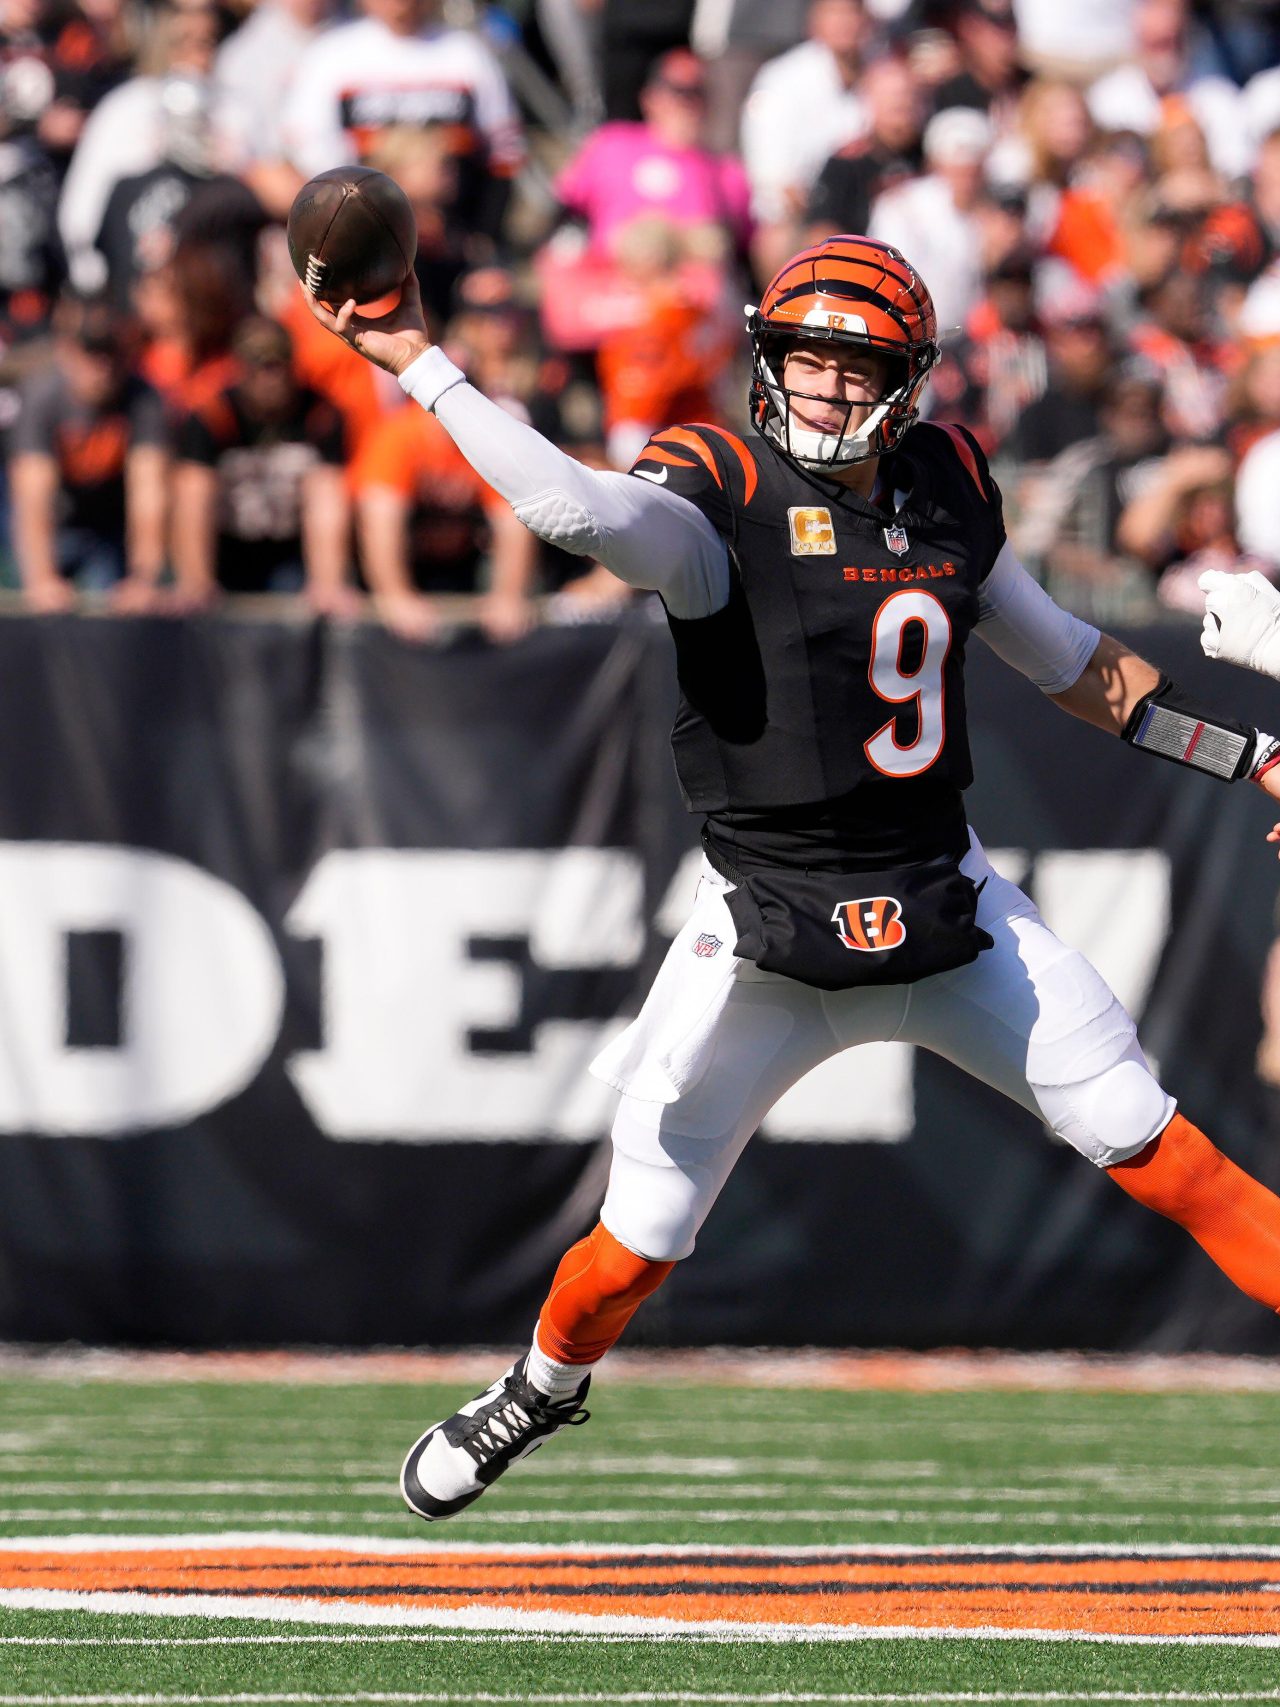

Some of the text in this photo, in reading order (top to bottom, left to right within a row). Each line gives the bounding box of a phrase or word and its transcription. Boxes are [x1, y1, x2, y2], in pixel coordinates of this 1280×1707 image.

[794, 511, 833, 544] C
[843, 561, 956, 582] BENGALS
[864, 589, 952, 778] 9
[831, 896, 906, 951] B
